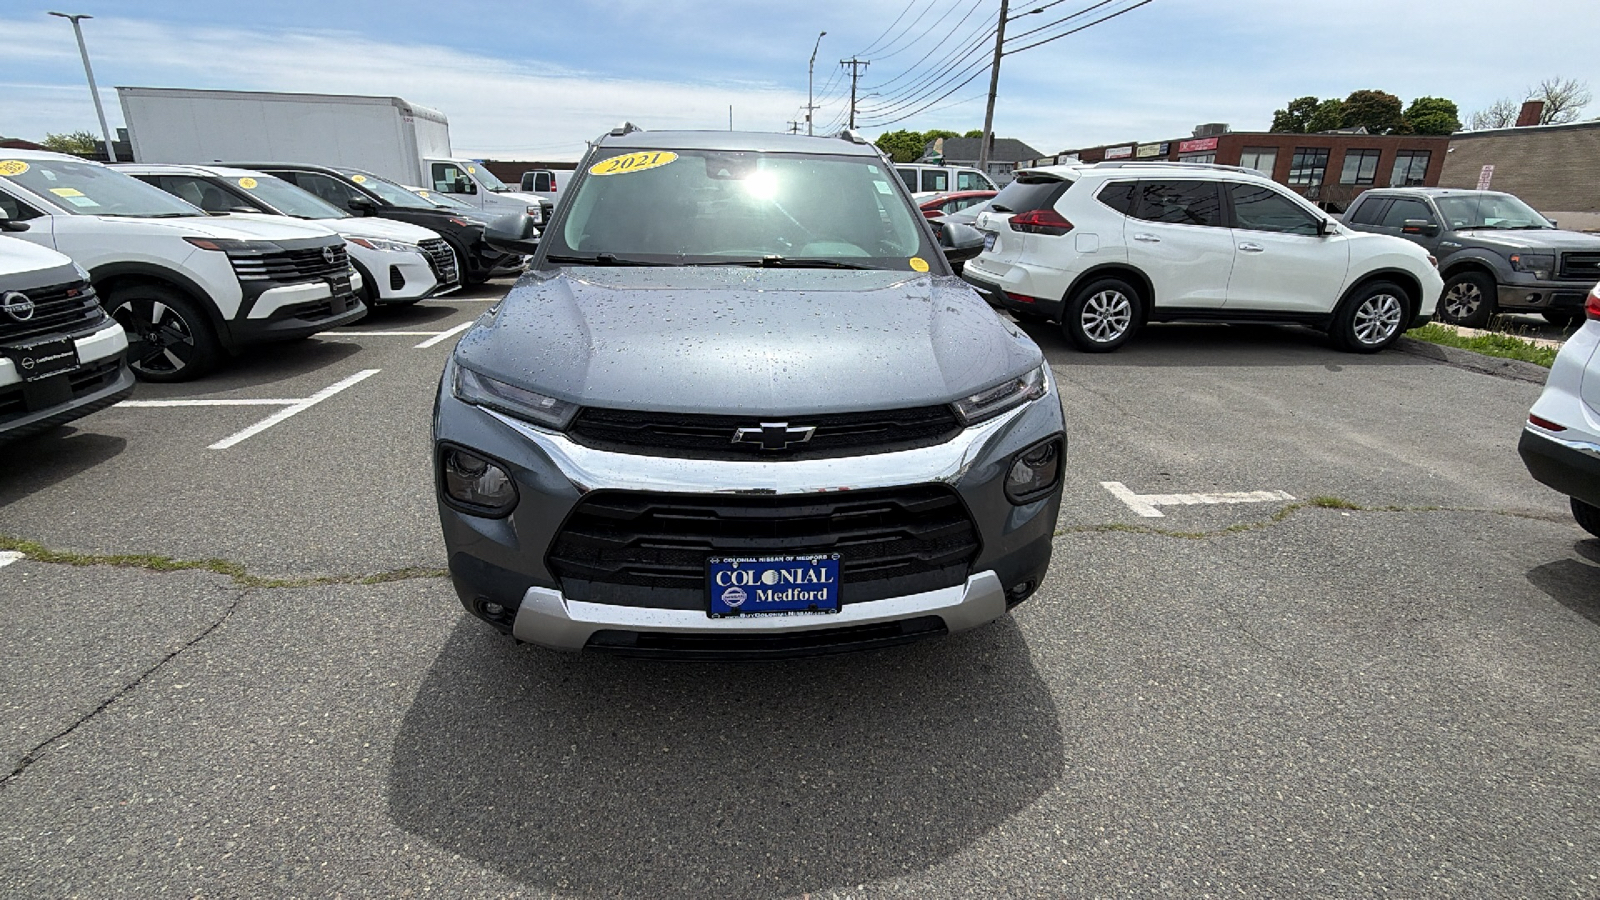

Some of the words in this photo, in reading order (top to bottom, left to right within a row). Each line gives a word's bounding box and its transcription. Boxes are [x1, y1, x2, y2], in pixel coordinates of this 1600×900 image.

[606, 153, 661, 172] 2021
[716, 567, 834, 587] COLONIAL
[756, 588, 828, 602] Medford
